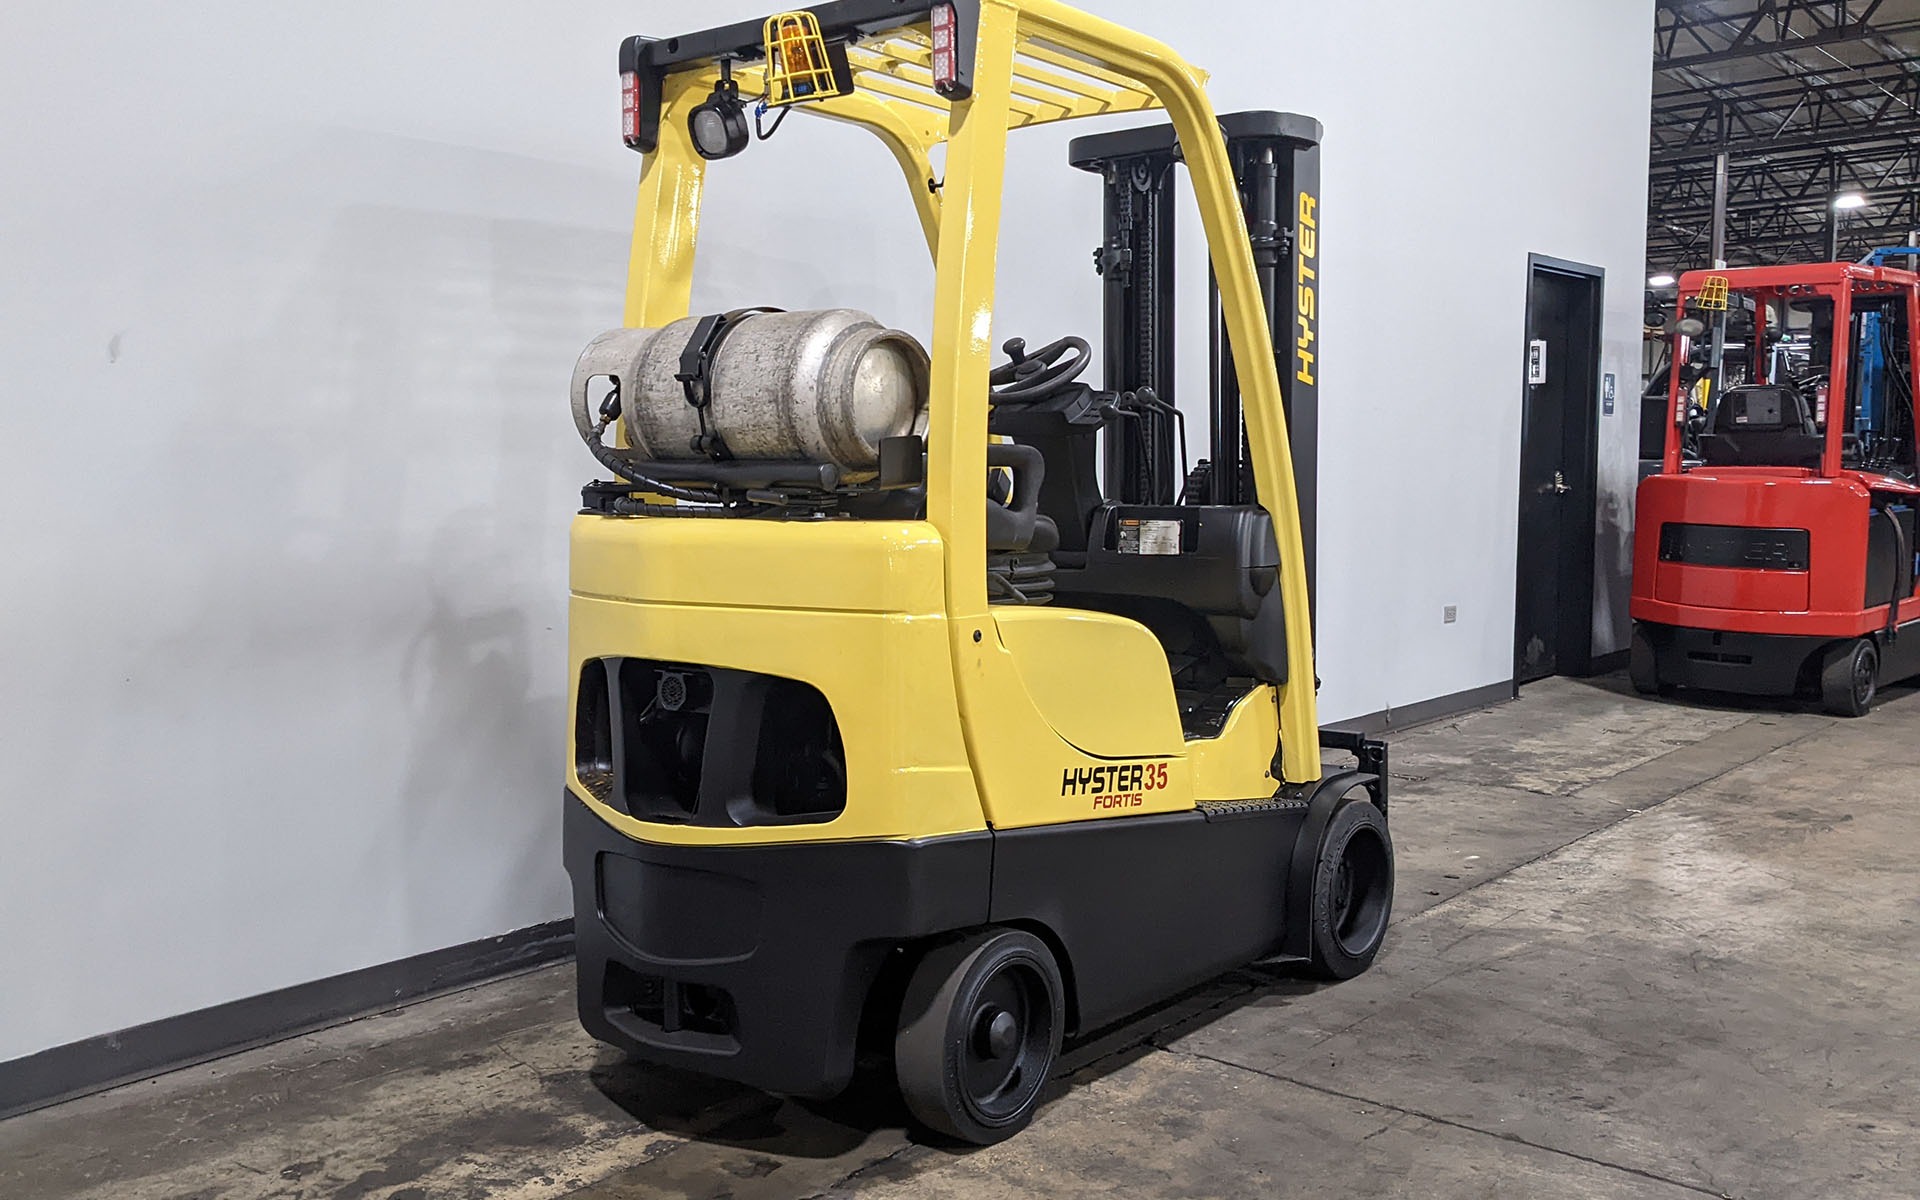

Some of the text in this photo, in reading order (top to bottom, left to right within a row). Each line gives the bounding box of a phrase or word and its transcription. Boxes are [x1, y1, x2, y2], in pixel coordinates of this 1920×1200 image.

[1297, 192, 1316, 386] HYSTER
[1062, 763, 1168, 796] HYSTER 35
[1093, 793, 1142, 809] FORTIS
